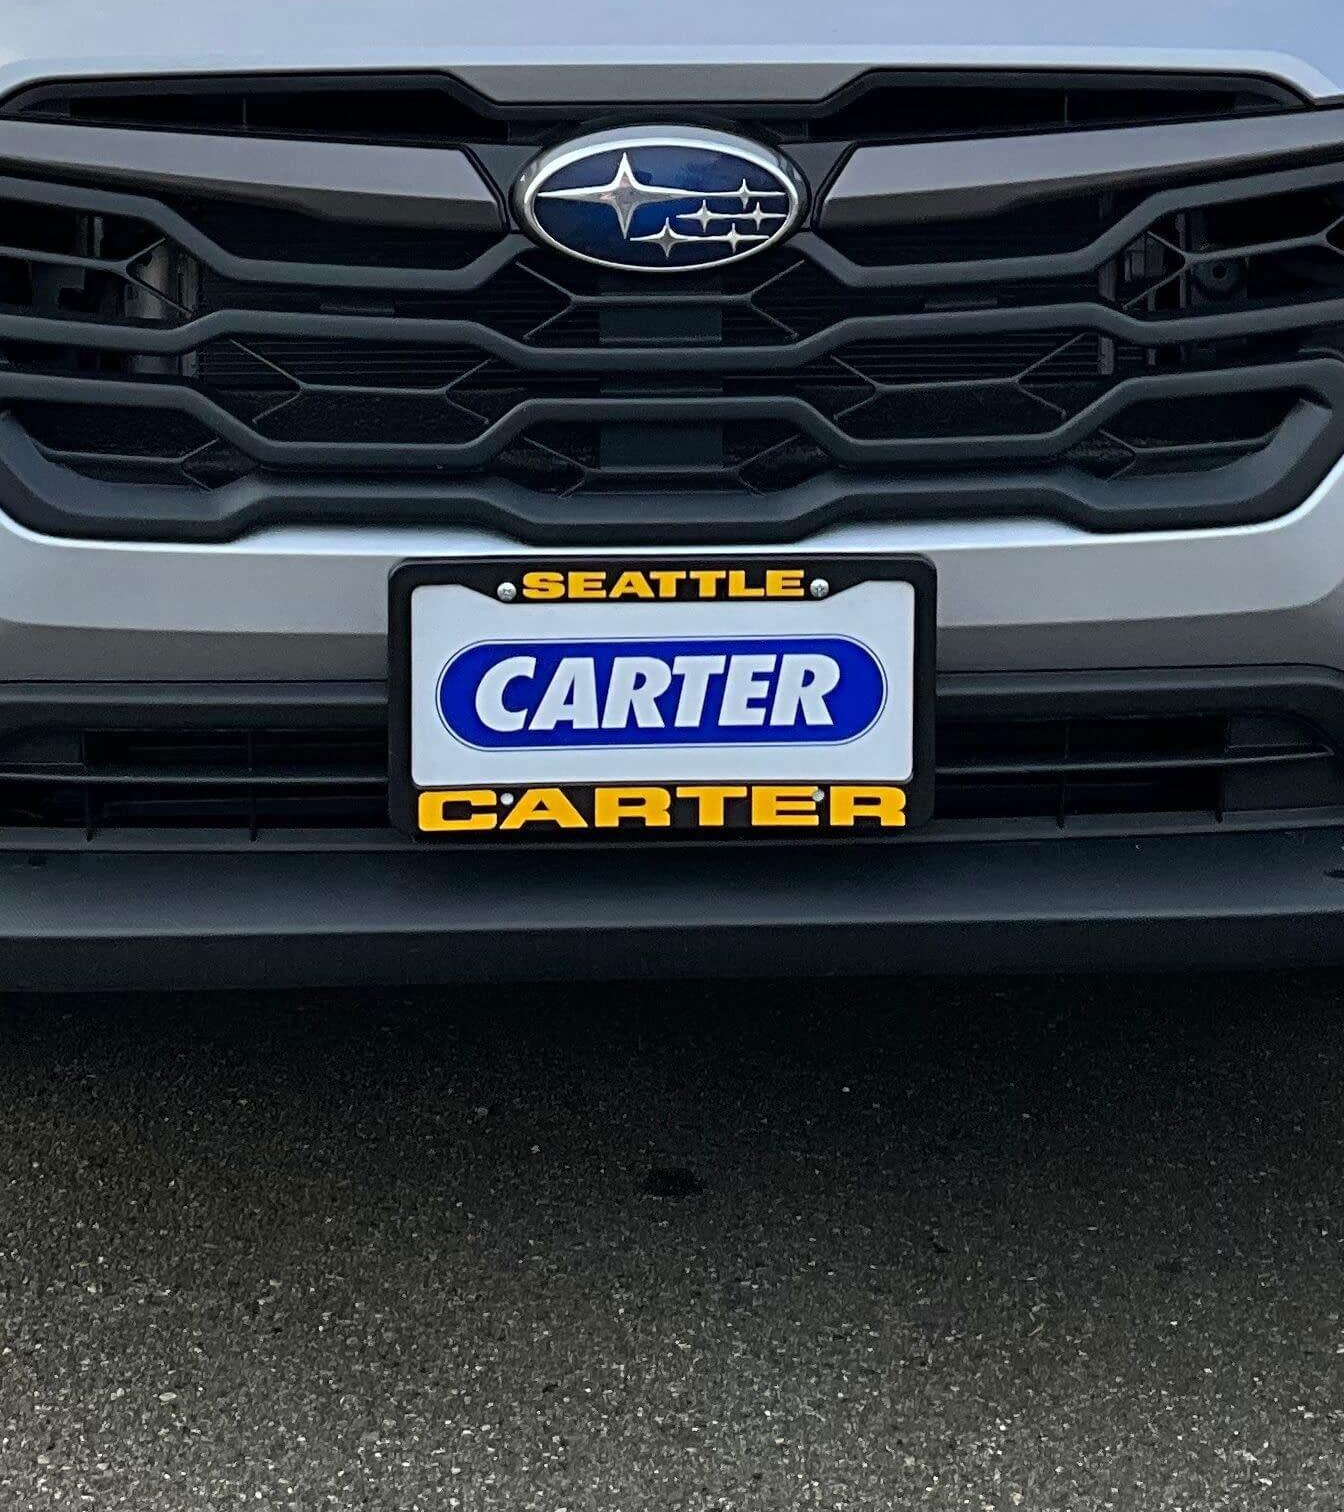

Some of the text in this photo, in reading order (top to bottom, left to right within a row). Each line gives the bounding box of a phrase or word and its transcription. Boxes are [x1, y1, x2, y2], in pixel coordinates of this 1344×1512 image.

[521, 569, 805, 600] SEATTLE
[474, 653, 841, 733] CARTER
[417, 785, 907, 832] CARTER
